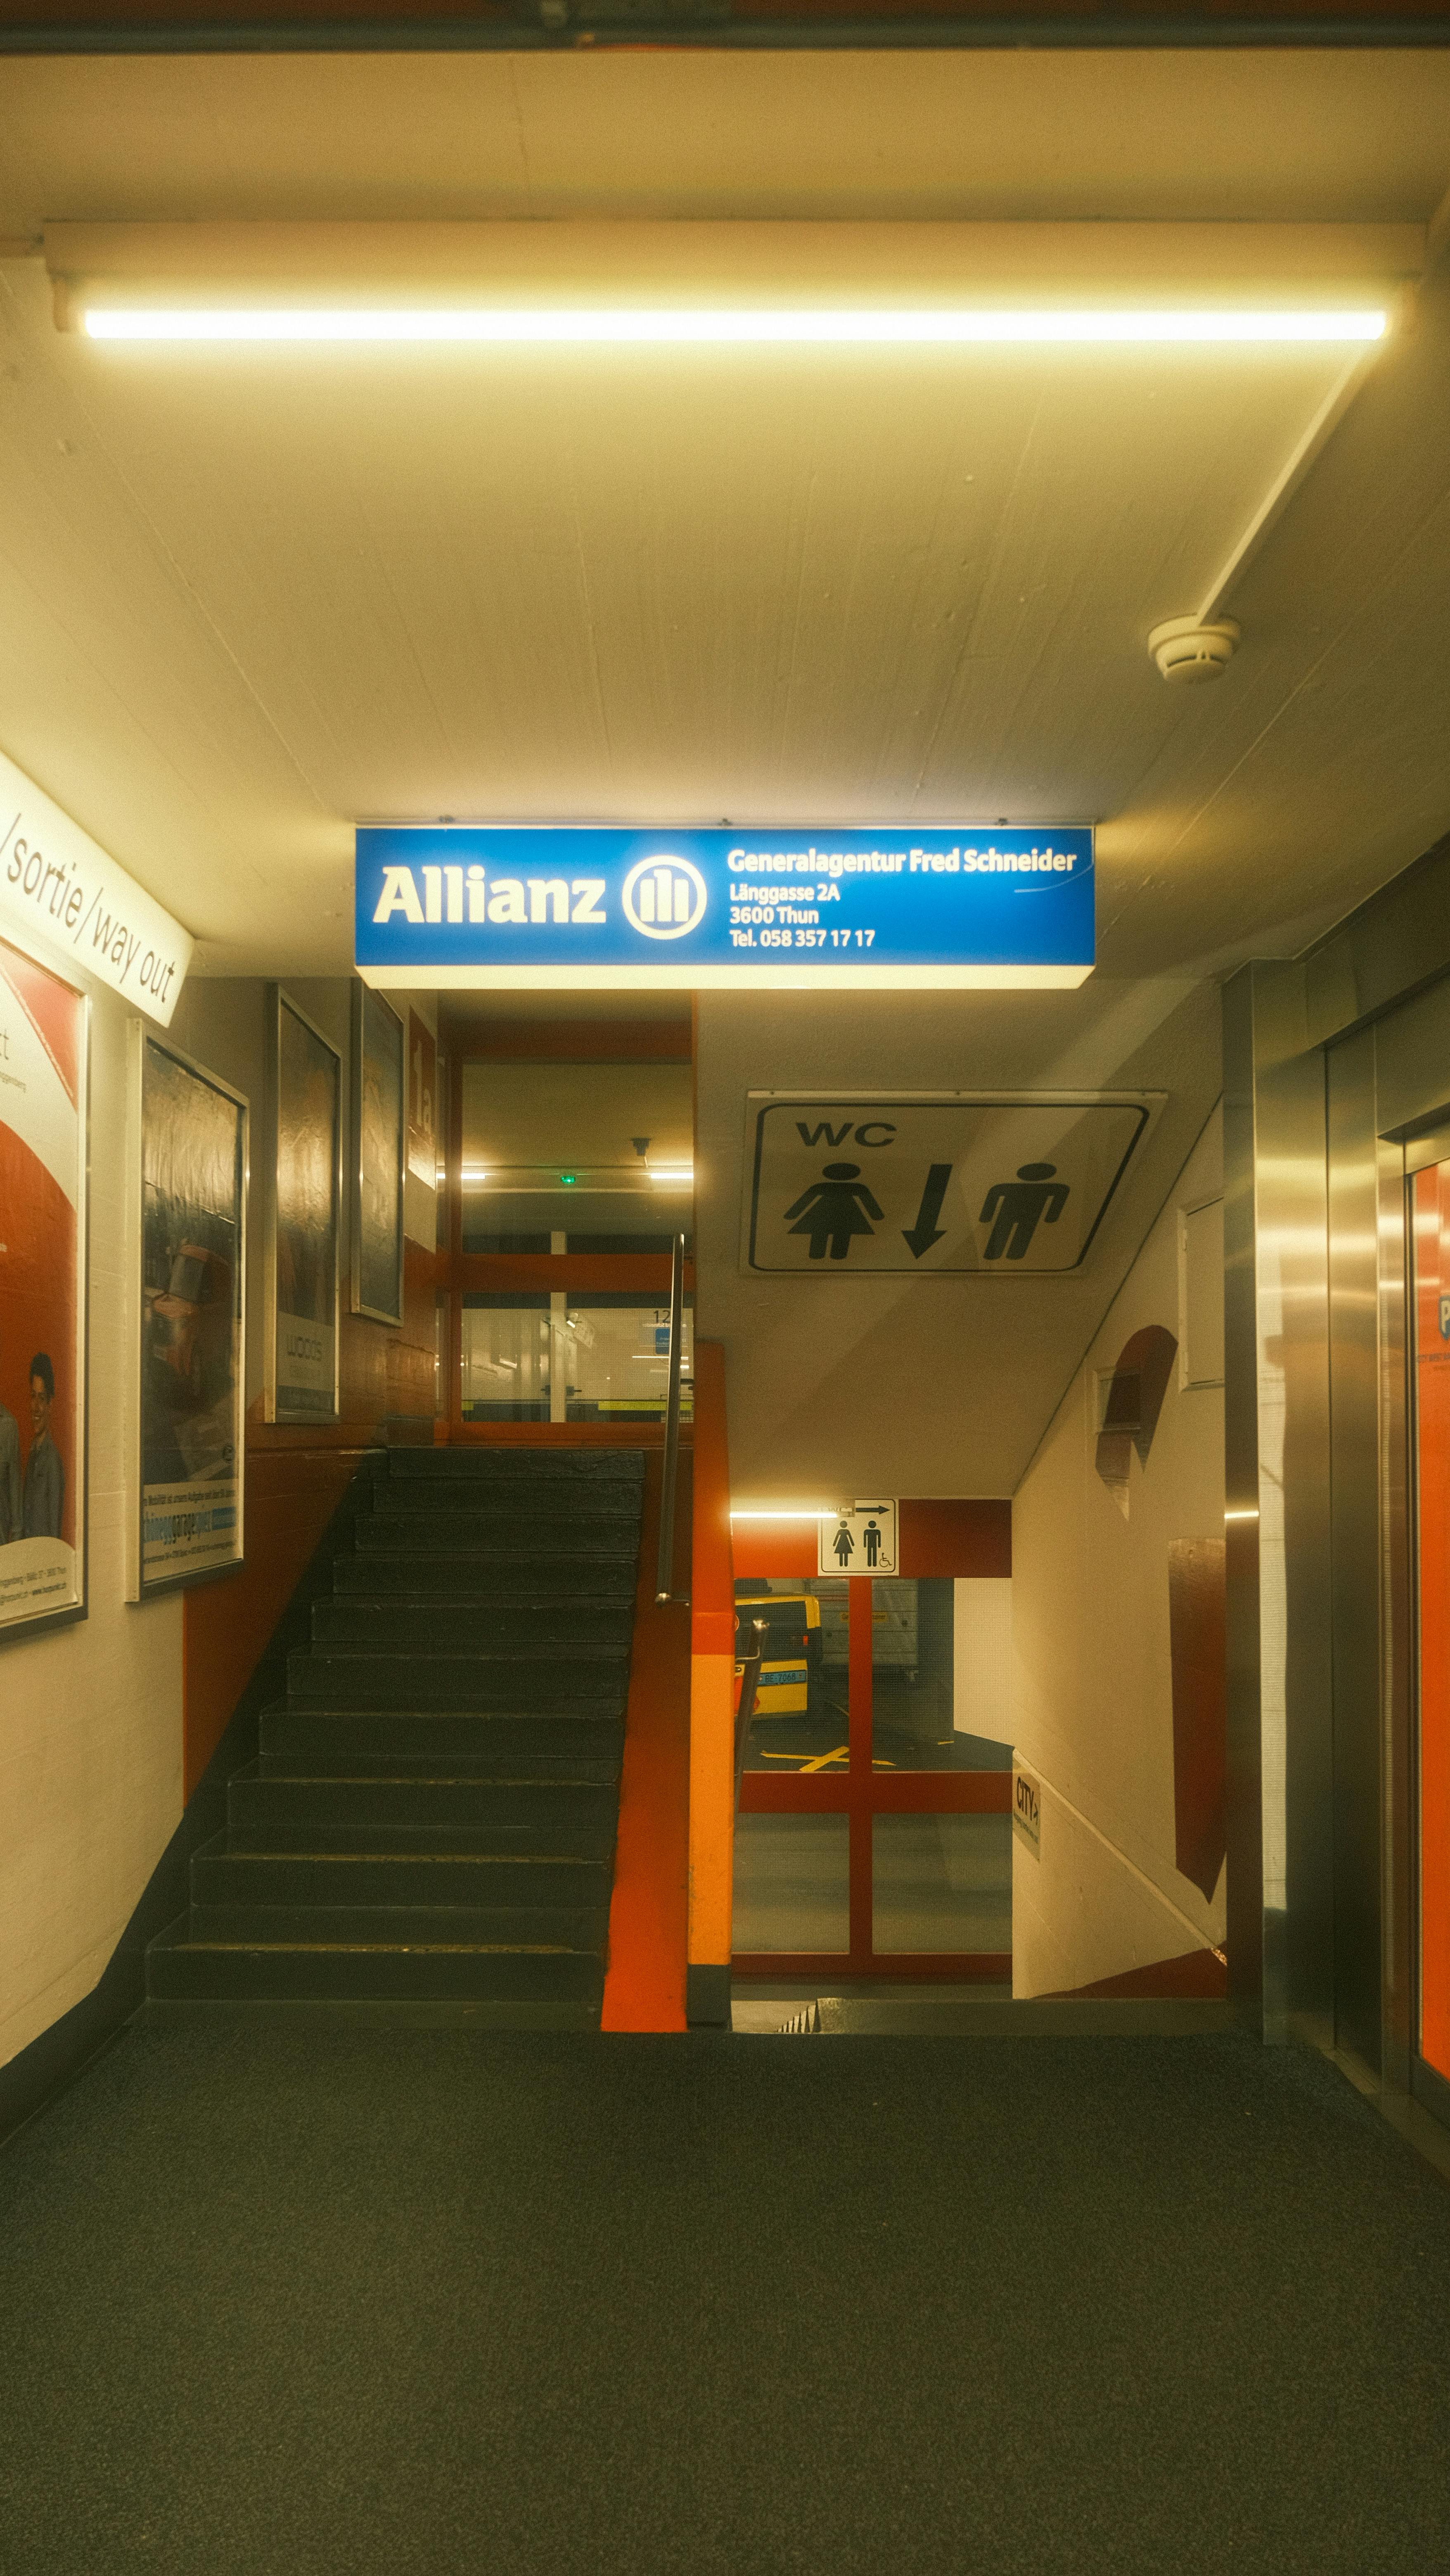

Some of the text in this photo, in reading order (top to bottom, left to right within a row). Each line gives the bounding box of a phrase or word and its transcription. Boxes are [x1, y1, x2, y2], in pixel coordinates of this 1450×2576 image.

[727, 848, 1077, 878] Generalagentur Fred Schneider
[373, 865, 607, 923] Allianz
[730, 883, 841, 905] Länggasse 2A
[730, 905, 819, 924] 3600 Thun
[729, 928, 876, 947] Tel. 058 357 17 17
[140, 950, 175, 1003] out
[796, 1122, 898, 1148] WC
[654, 1310, 670, 1323] 12
[1017, 1776, 1034, 1821] CITY
